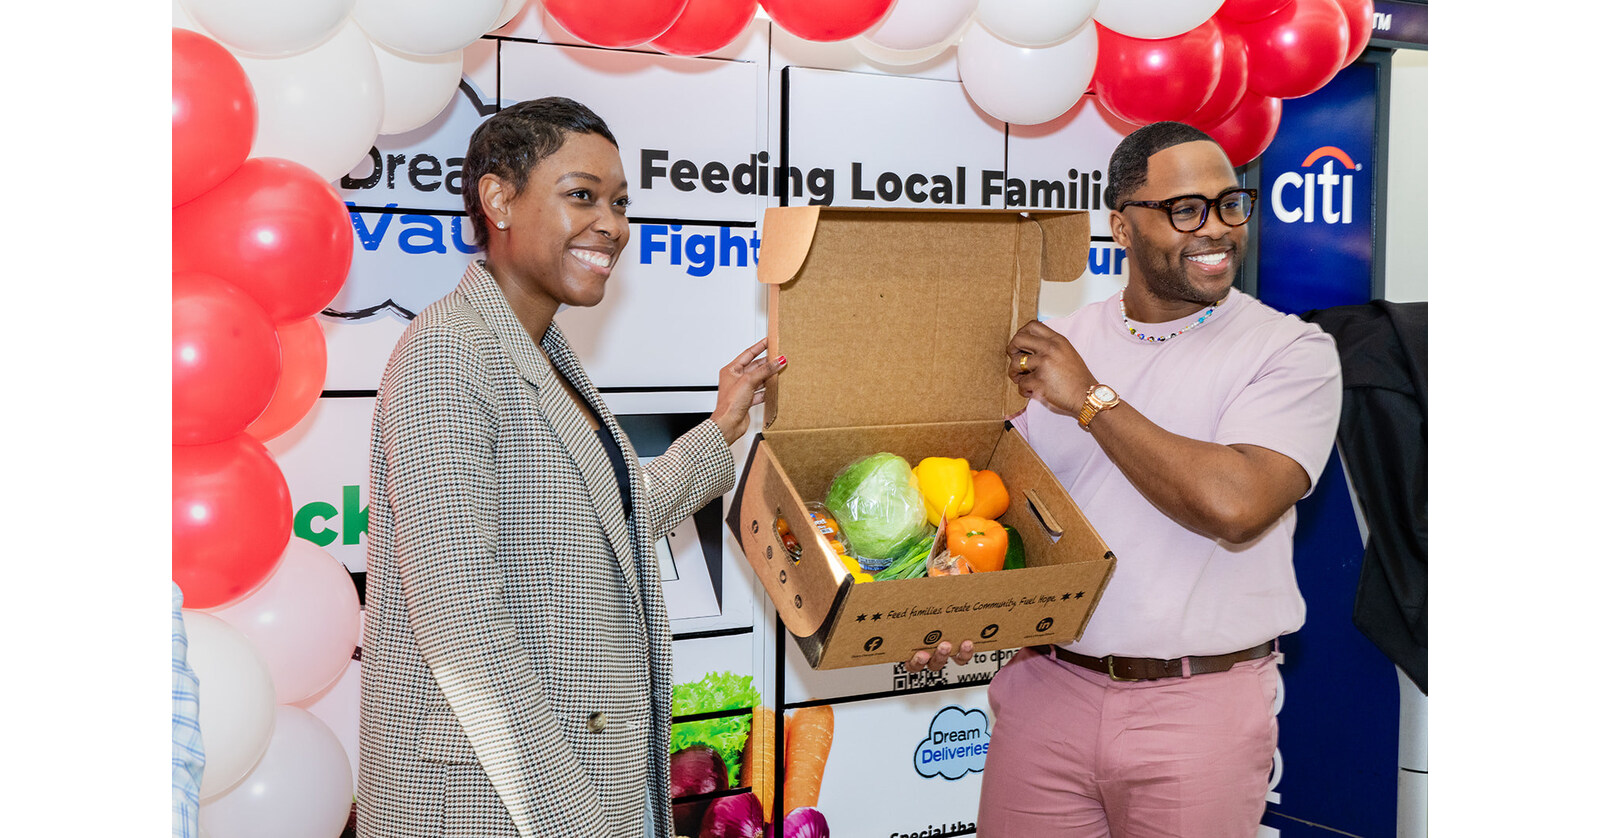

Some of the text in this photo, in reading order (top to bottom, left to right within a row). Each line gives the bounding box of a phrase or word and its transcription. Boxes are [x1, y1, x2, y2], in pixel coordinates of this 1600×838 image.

[640, 149, 835, 207] Feeding
[851, 162, 966, 205] Local
[1271, 160, 1353, 225] citi
[1085, 248, 1126, 275] ur
[887, 608, 908, 619] Feed
[945, 602, 971, 613] Create
[1019, 595, 1037, 606] Fuel
[973, 653, 987, 664] to
[933, 728, 980, 745] Dream
[922, 743, 989, 764] Deliveries
